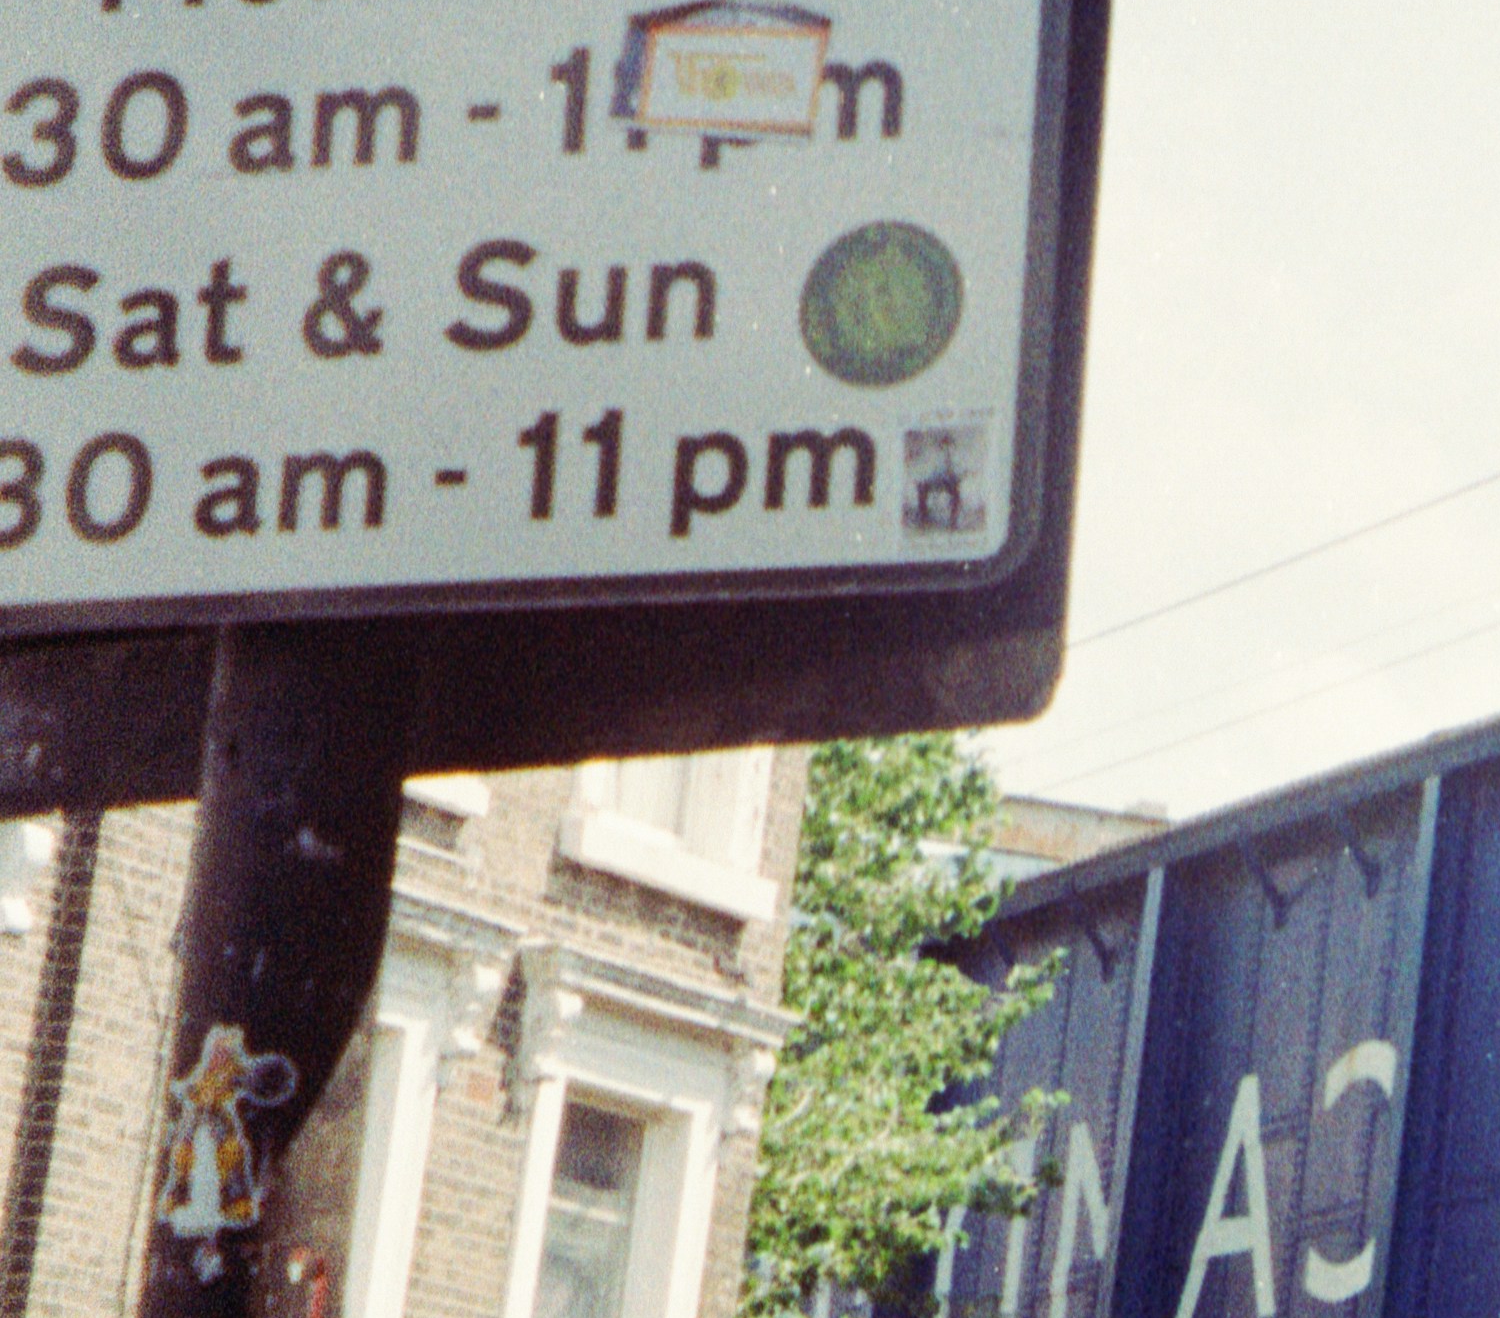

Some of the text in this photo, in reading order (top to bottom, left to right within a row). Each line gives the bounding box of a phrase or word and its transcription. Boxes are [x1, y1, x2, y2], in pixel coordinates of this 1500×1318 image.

[228, 80, 420, 175] am
[10, 259, 247, 377] Sat
[302, 248, 385, 359] &
[444, 238, 720, 353] Sun
[193, 446, 387, 539] am
[518, 409, 624, 520] 11
[668, 423, 878, 539] pm
